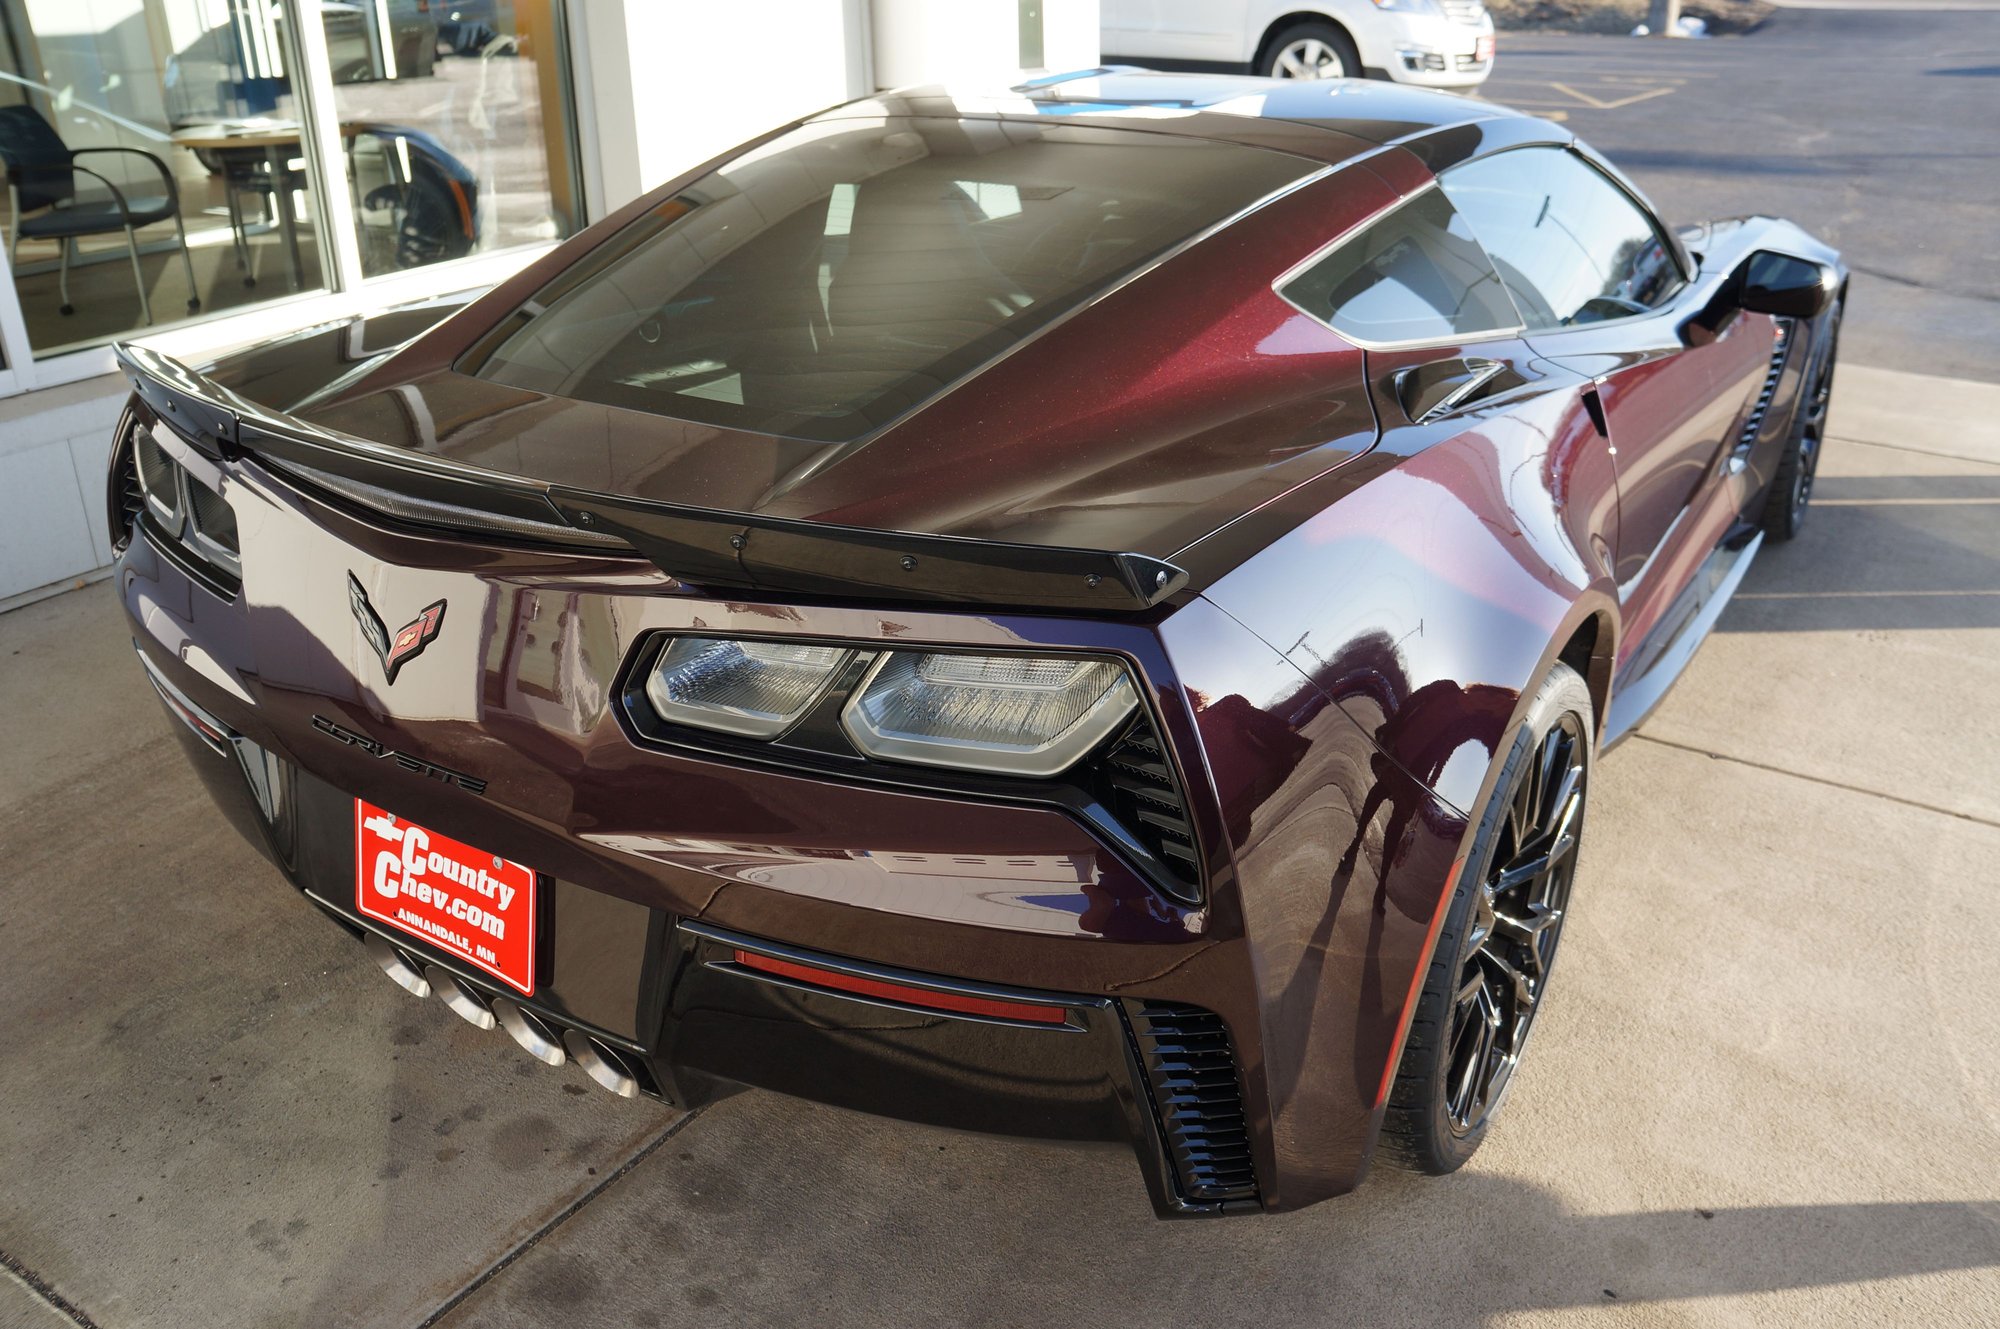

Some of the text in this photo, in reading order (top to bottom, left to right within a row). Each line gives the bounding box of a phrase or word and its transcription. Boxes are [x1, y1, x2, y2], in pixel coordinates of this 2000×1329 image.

[312, 714, 488, 795] CORVETTE
[374, 851, 505, 940] Chev.com
[401, 826, 515, 911] Country
[397, 907, 496, 964] ANNANDALE, MN
